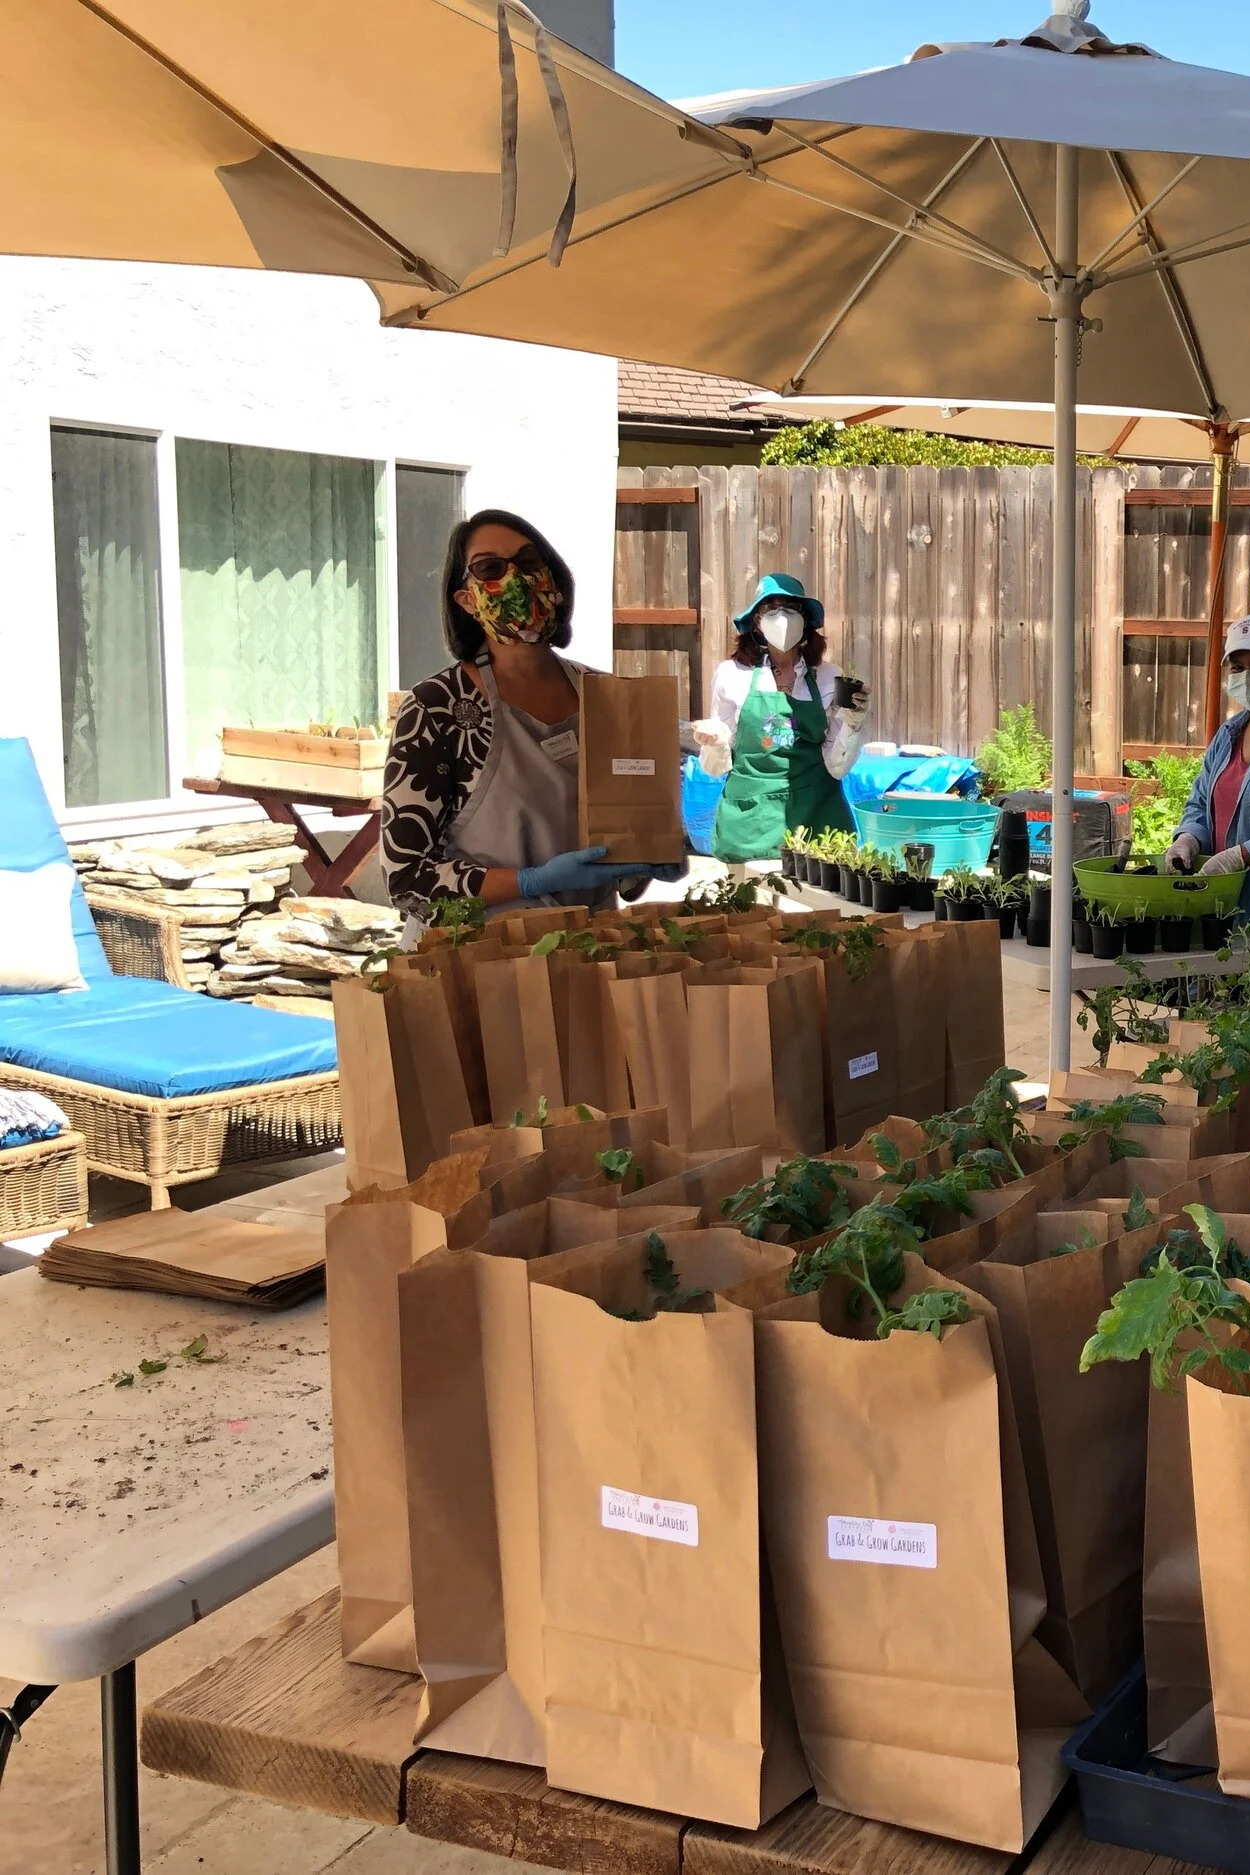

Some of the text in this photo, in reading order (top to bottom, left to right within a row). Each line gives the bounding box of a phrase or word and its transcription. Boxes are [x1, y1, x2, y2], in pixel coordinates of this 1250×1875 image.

[608, 1502, 626, 1518] GRAB
[627, 1506, 633, 1519] &
[635, 1509, 655, 1526] GROW
[656, 1513, 689, 1532] GARDENS
[835, 1532, 927, 1554] GRAB & GROW GARDENS
